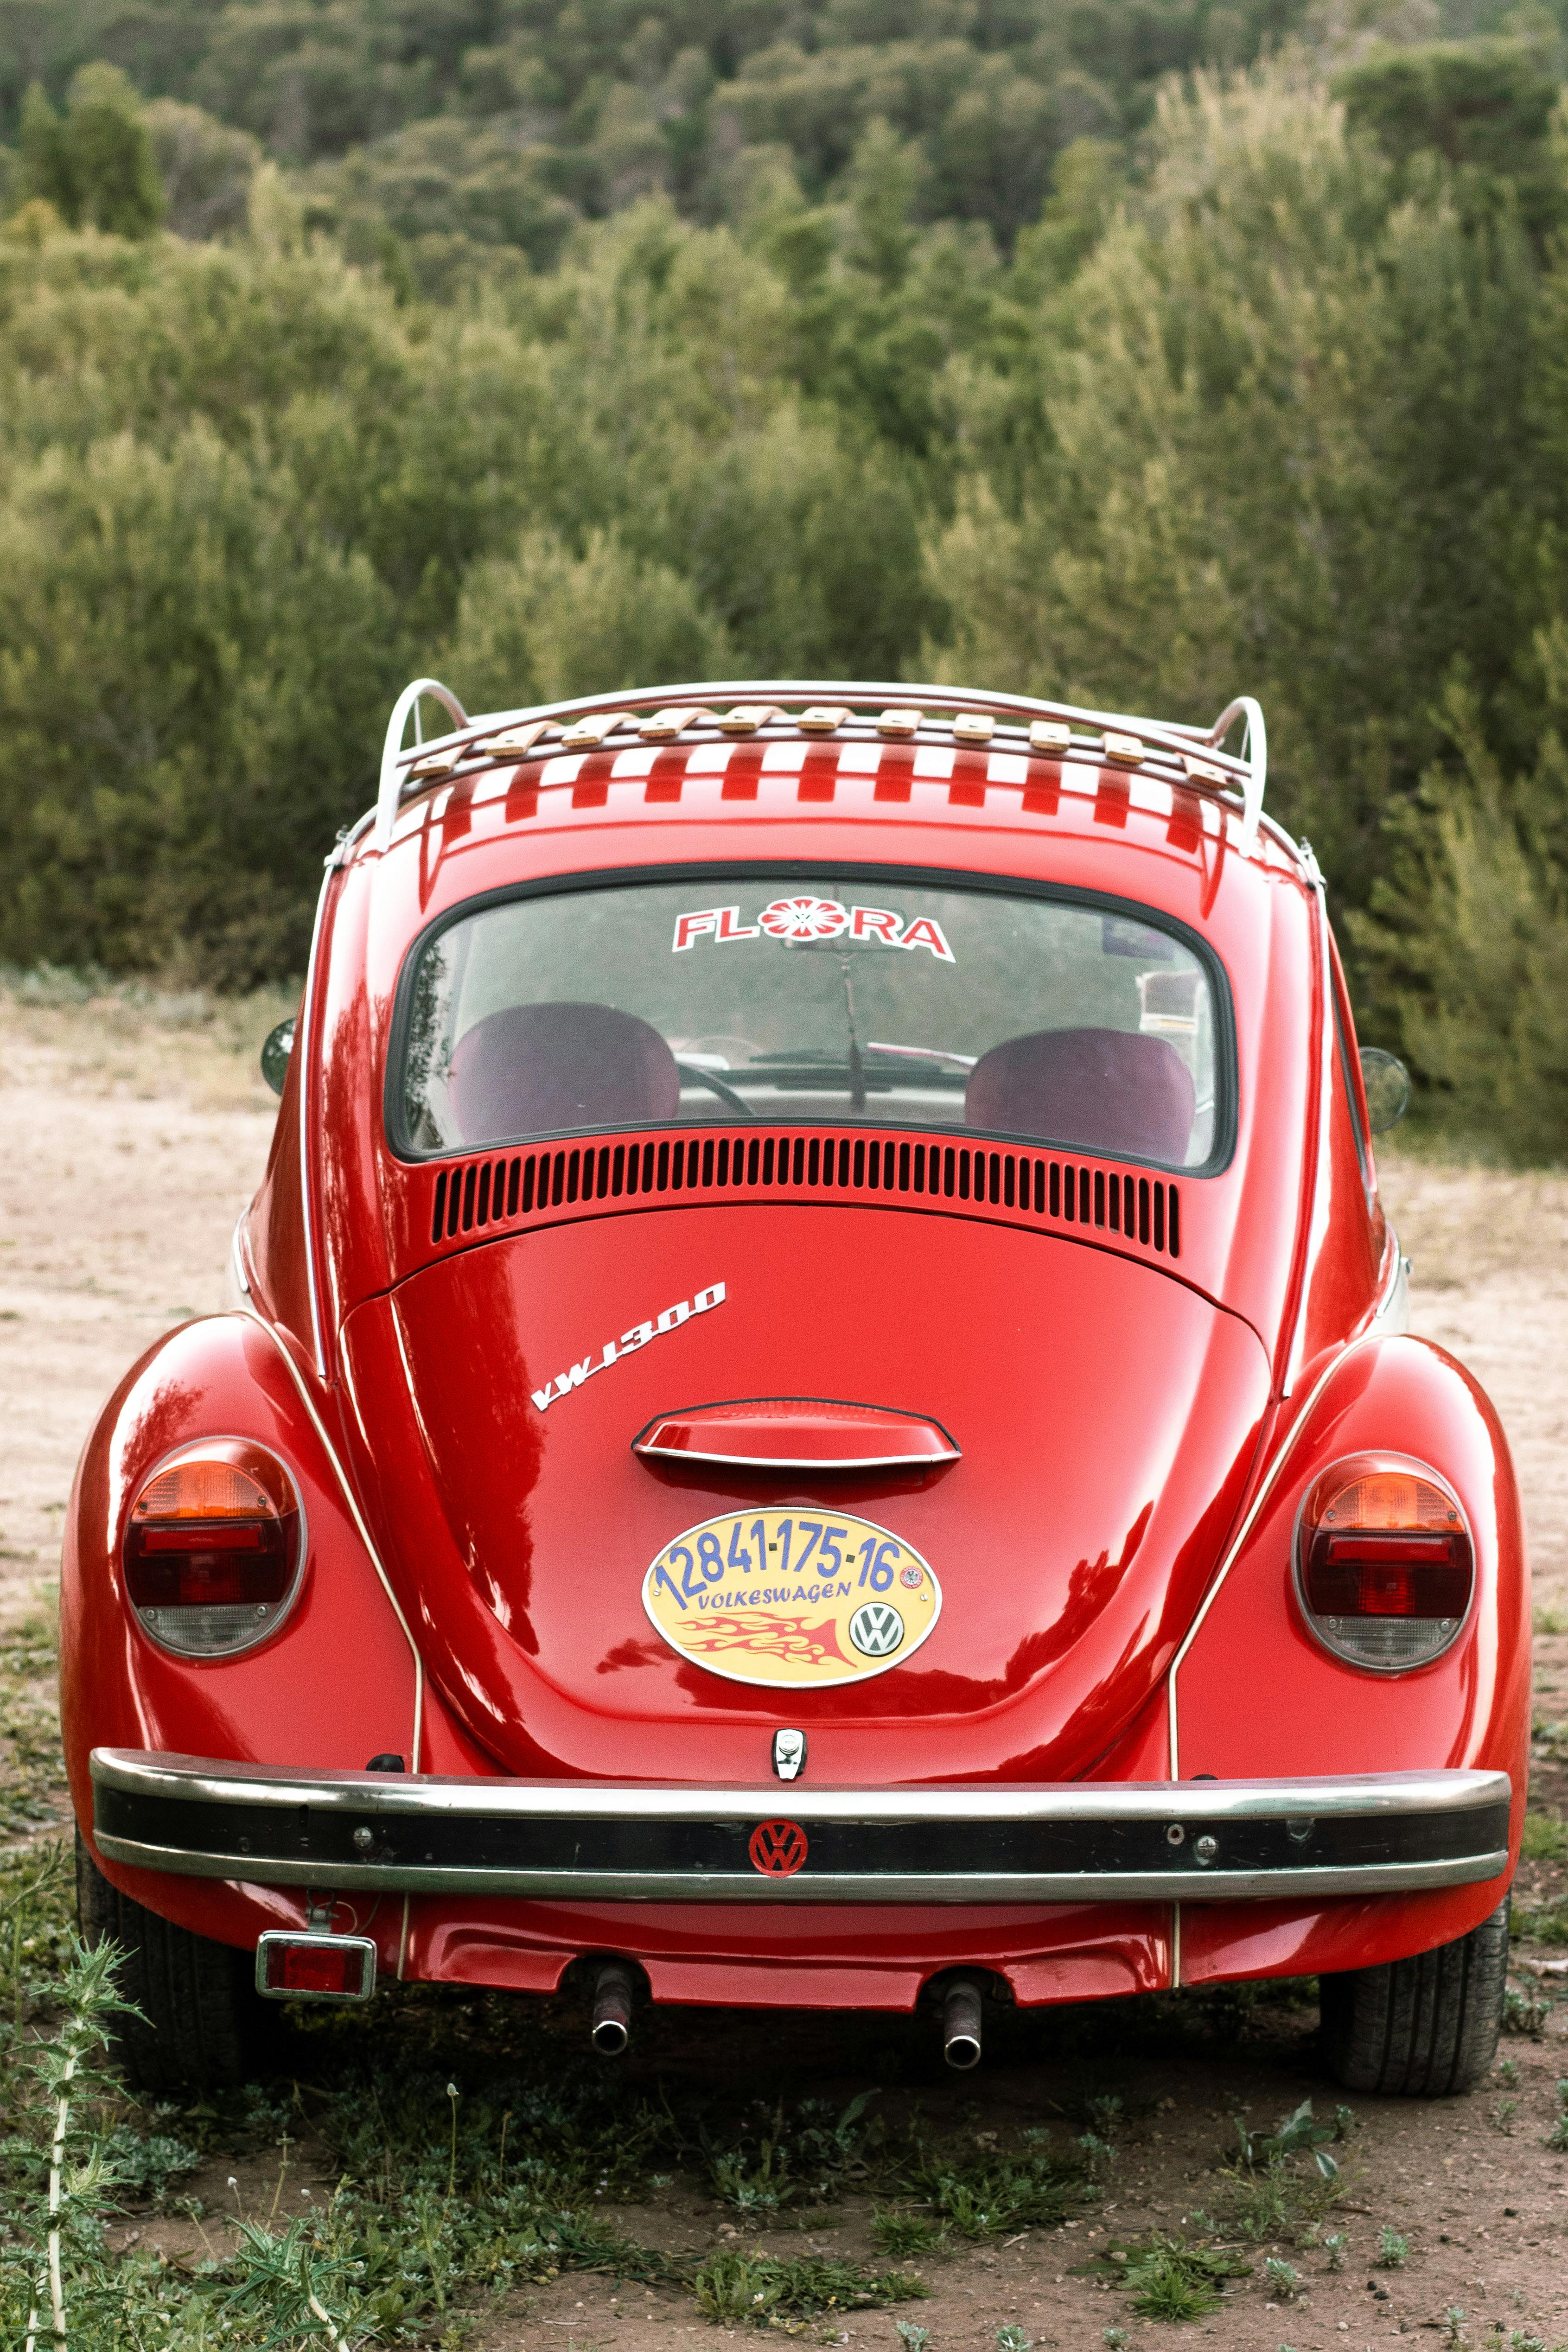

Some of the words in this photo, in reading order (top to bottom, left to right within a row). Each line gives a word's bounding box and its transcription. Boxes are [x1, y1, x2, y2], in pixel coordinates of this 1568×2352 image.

[530, 1356, 591, 1412] VW
[602, 1281, 726, 1367] 1300
[698, 1581, 852, 1610] VOLKESWAGEN
[852, 1605, 901, 1654] VW
[752, 1821, 805, 1874] VW
